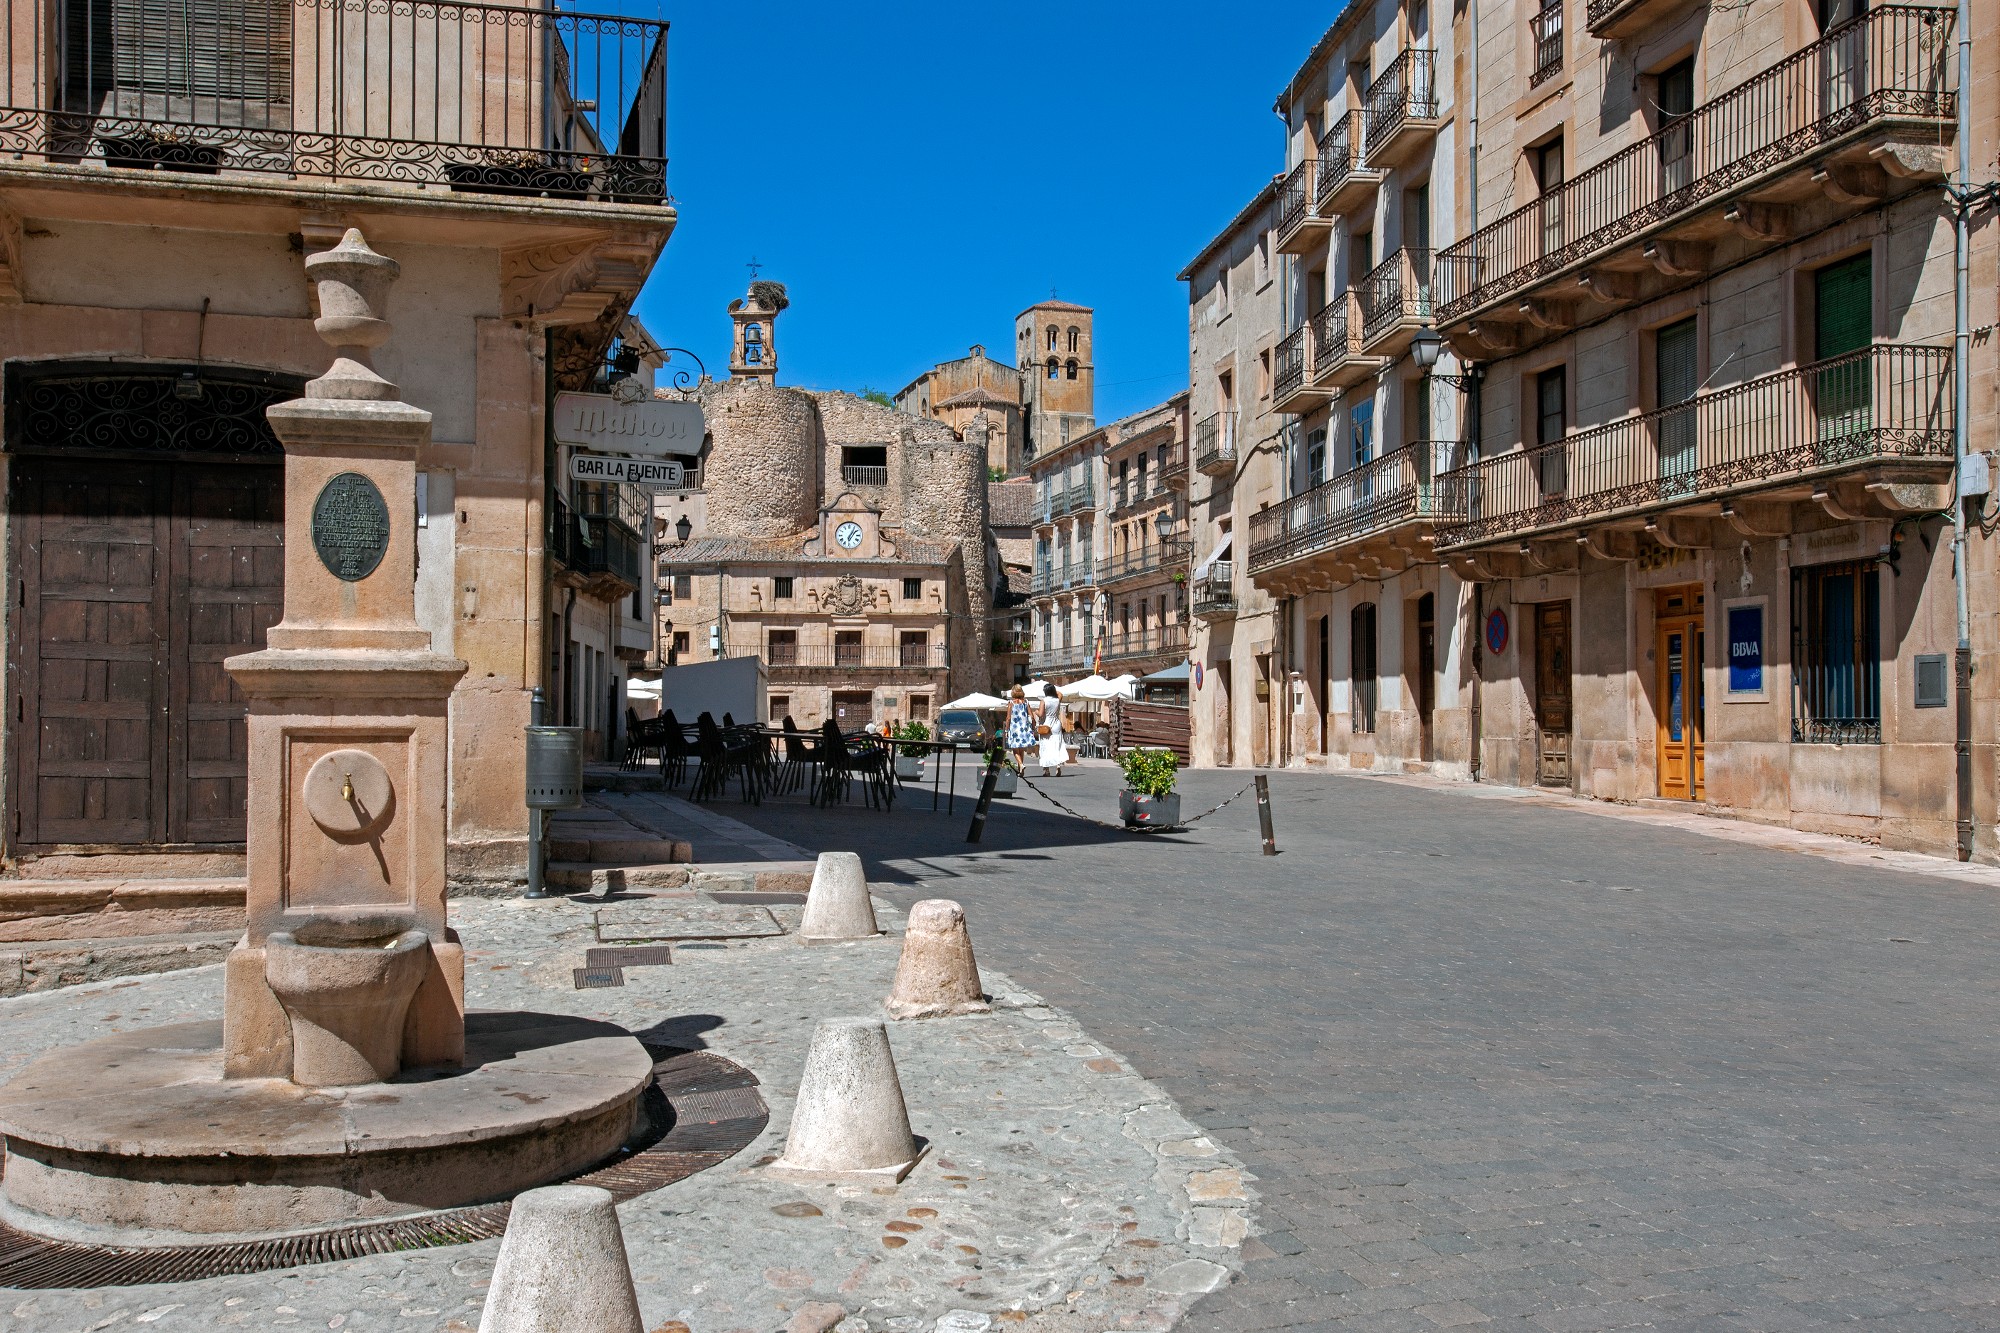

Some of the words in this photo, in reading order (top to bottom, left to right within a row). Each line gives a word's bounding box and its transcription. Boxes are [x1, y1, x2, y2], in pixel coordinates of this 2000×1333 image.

[570, 405, 687, 440] Mahou
[577, 459, 604, 475] BAR
[607, 461, 624, 476] LA
[628, 463, 676, 481] FUENTE
[1807, 530, 1860, 549] Autorizado
[1637, 543, 1697, 571] BBVA
[1732, 641, 1759, 657] BBVA
